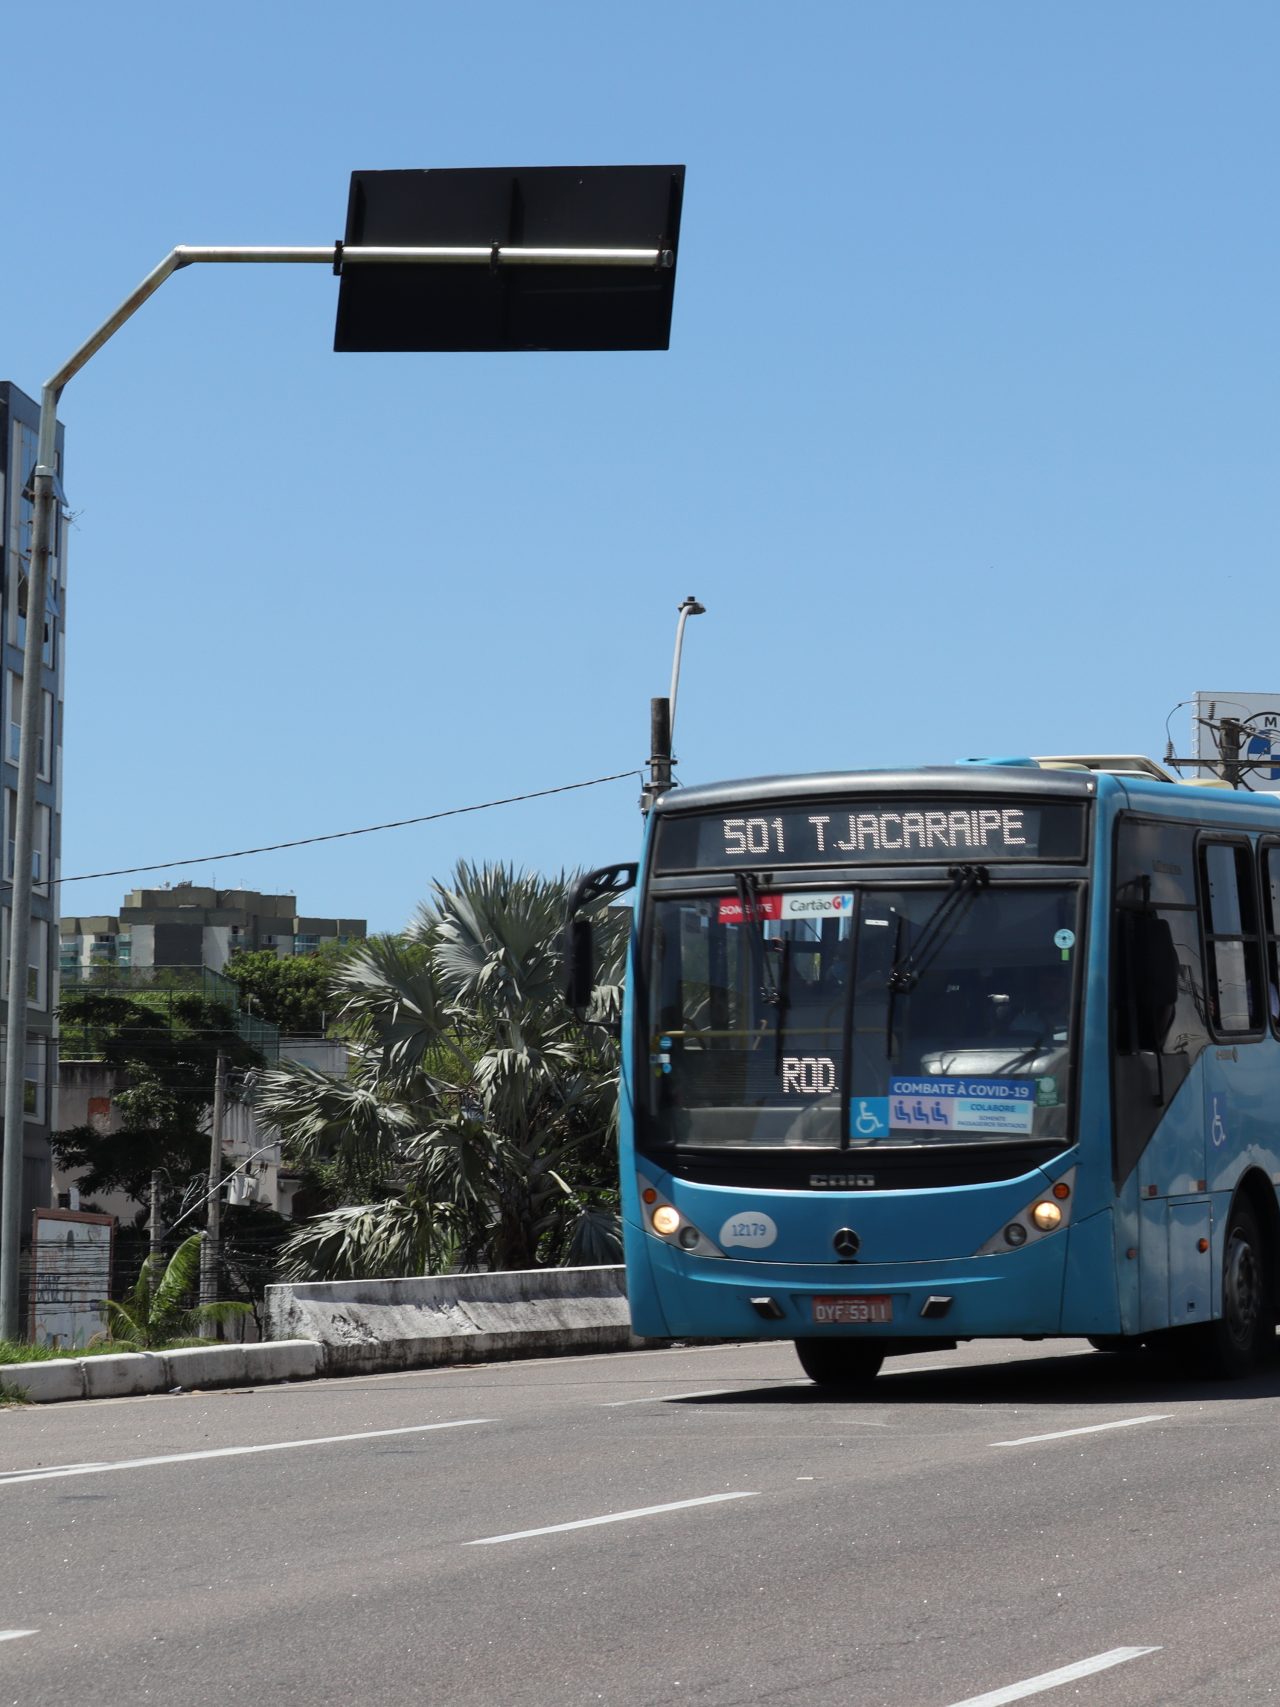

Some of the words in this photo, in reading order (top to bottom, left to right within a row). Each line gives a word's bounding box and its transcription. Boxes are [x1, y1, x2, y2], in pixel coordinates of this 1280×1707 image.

[723, 817, 784, 854] 501
[783, 1057, 839, 1093] ROD.
[894, 1082, 954, 1095] COMBATE
[957, 1081, 970, 1095] À
[971, 1084, 1029, 1098] COVID-19
[971, 1103, 1016, 1113] COLABORE
[732, 1223, 767, 1237] 12179
